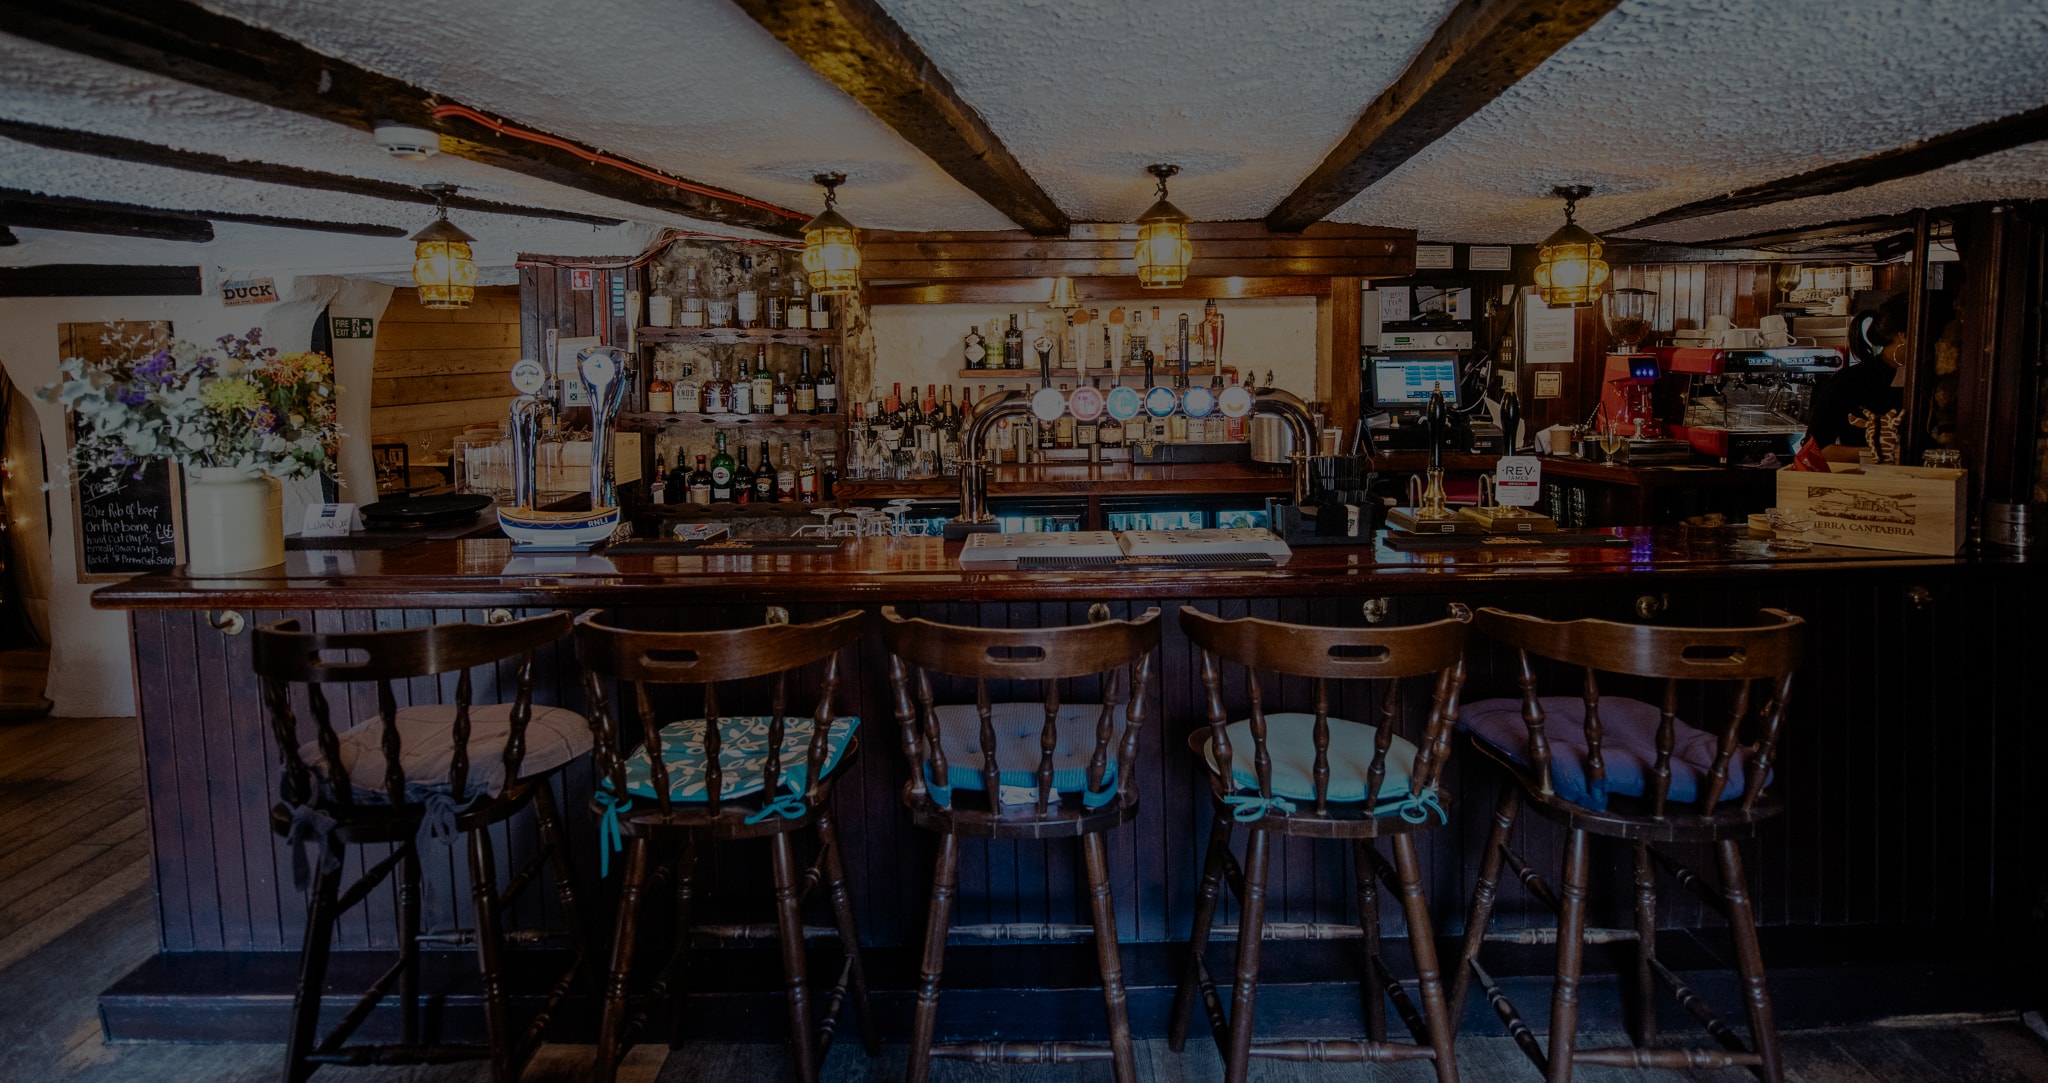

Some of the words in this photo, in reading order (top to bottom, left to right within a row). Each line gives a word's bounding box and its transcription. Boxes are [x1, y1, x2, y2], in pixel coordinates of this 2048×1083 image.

[223, 285, 272, 300] DUCK
[335, 319, 350, 328] FIRE
[336, 328, 349, 337] EXIT
[1505, 466, 1533, 475] REV
[109, 502, 124, 518] Rib
[126, 503, 135, 520] of
[137, 500, 159, 519] beef
[588, 517, 609, 528] RNLI
[1811, 520, 1846, 530] IERRA
[1849, 523, 1915, 536] CANTABRIA
